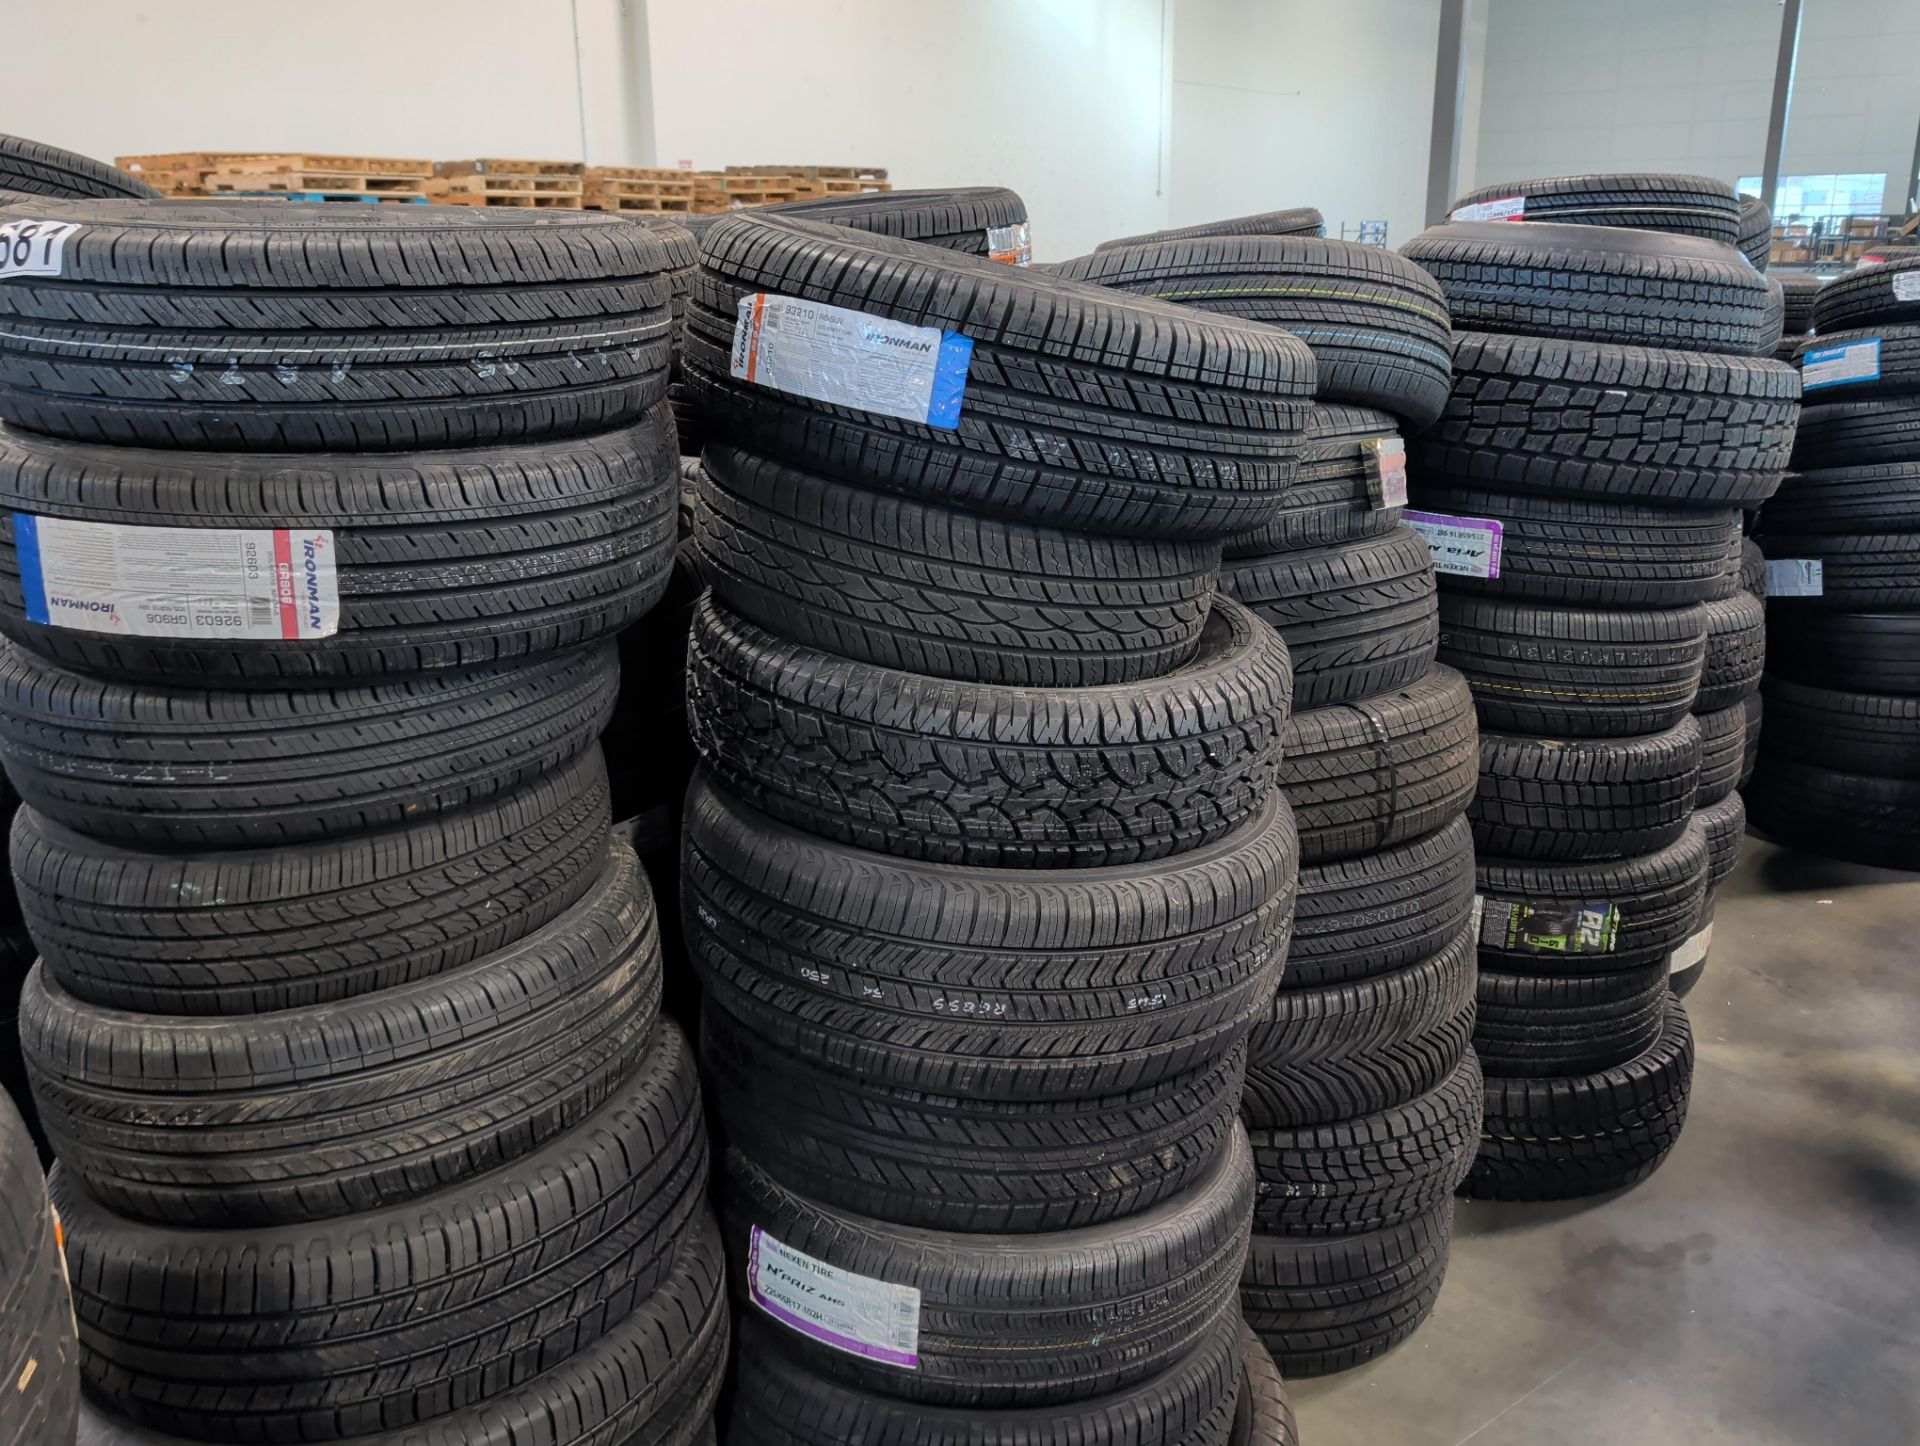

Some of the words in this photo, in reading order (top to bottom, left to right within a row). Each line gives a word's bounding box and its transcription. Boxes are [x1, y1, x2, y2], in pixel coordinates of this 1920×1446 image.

[785, 304, 814, 320] 93210
[245, 541, 260, 580] 92603
[303, 538, 322, 631] IRONMAN
[50, 596, 115, 614] IRONMAN
[146, 613, 188, 625] GR906
[196, 614, 243, 627] 92603
[779, 1249, 809, 1270] NEXEN
[812, 1264, 834, 1279] TIRE
